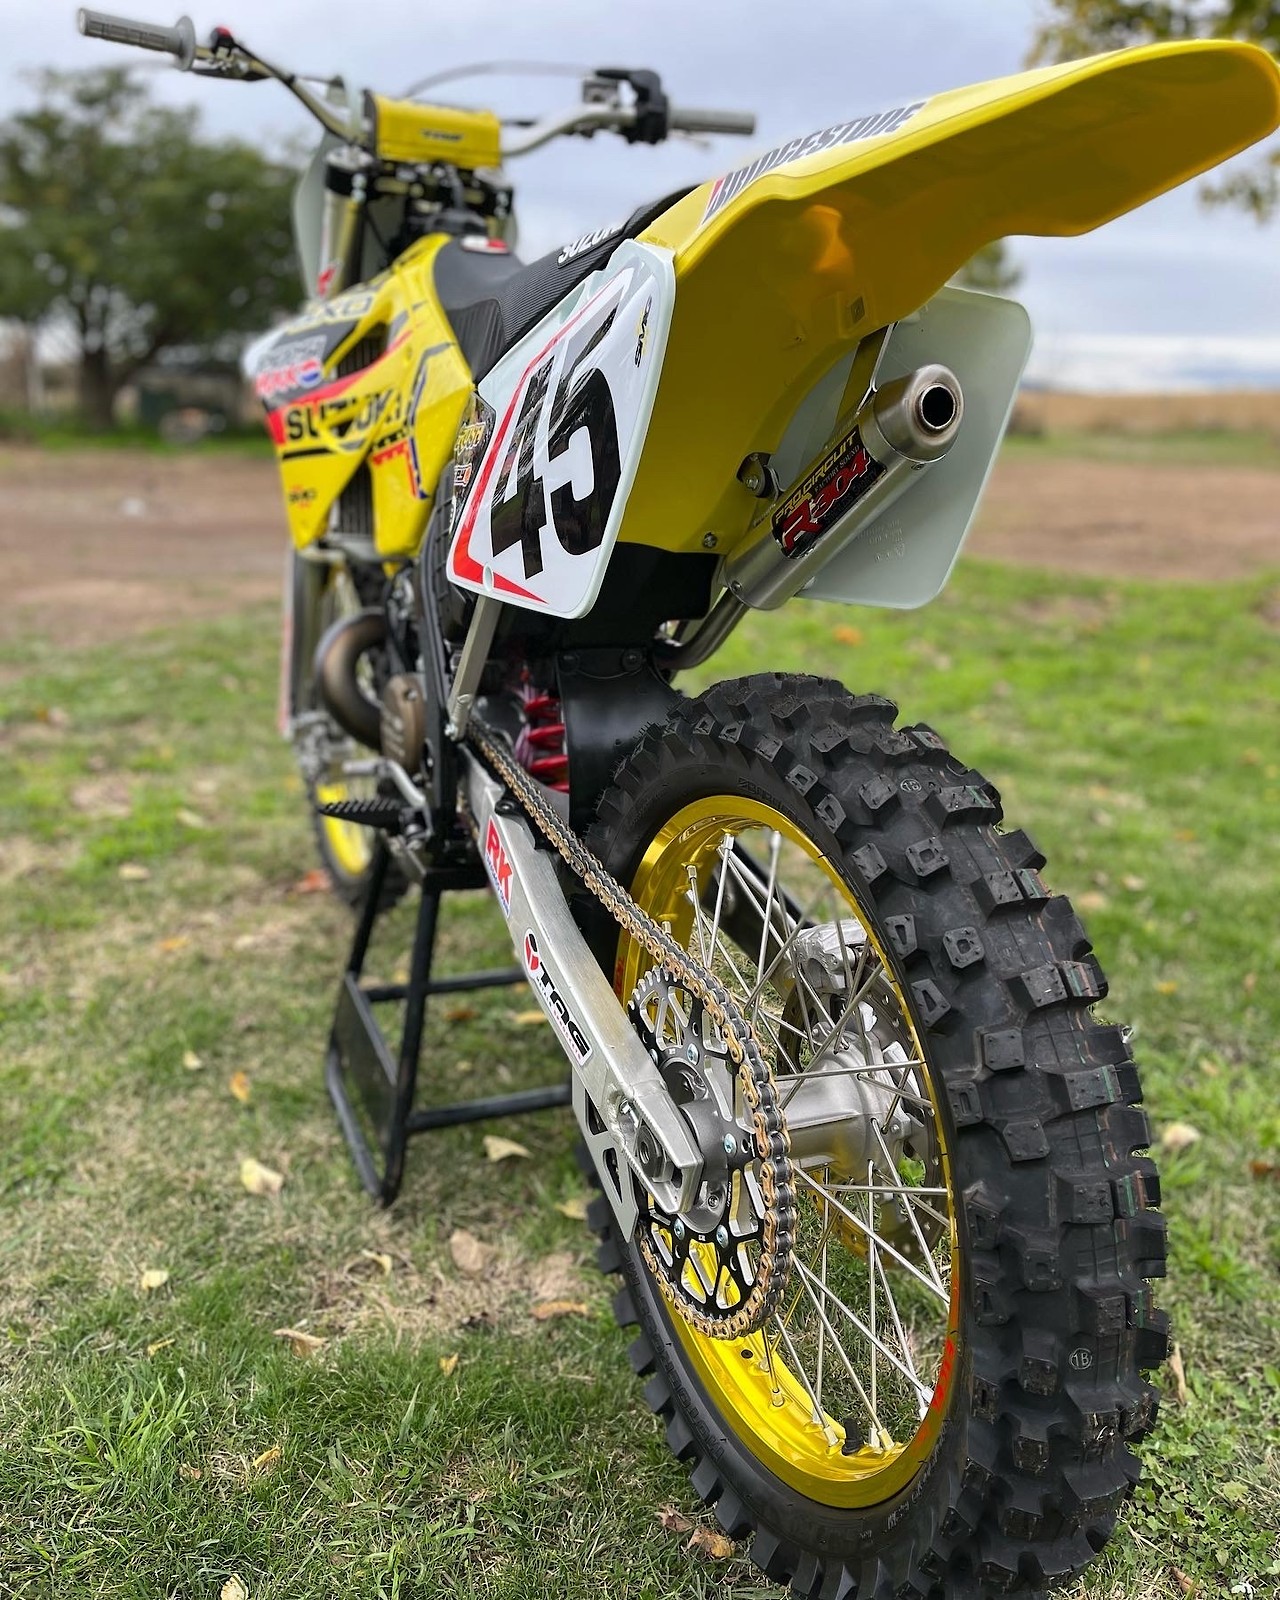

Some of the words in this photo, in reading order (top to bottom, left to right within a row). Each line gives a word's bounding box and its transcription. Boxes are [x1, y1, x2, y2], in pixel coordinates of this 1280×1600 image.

[701, 102, 928, 224] BRIDGESTONE
[491, 304, 621, 580] 45
[485, 819, 513, 901] RK
[539, 961, 591, 1057] TAG
